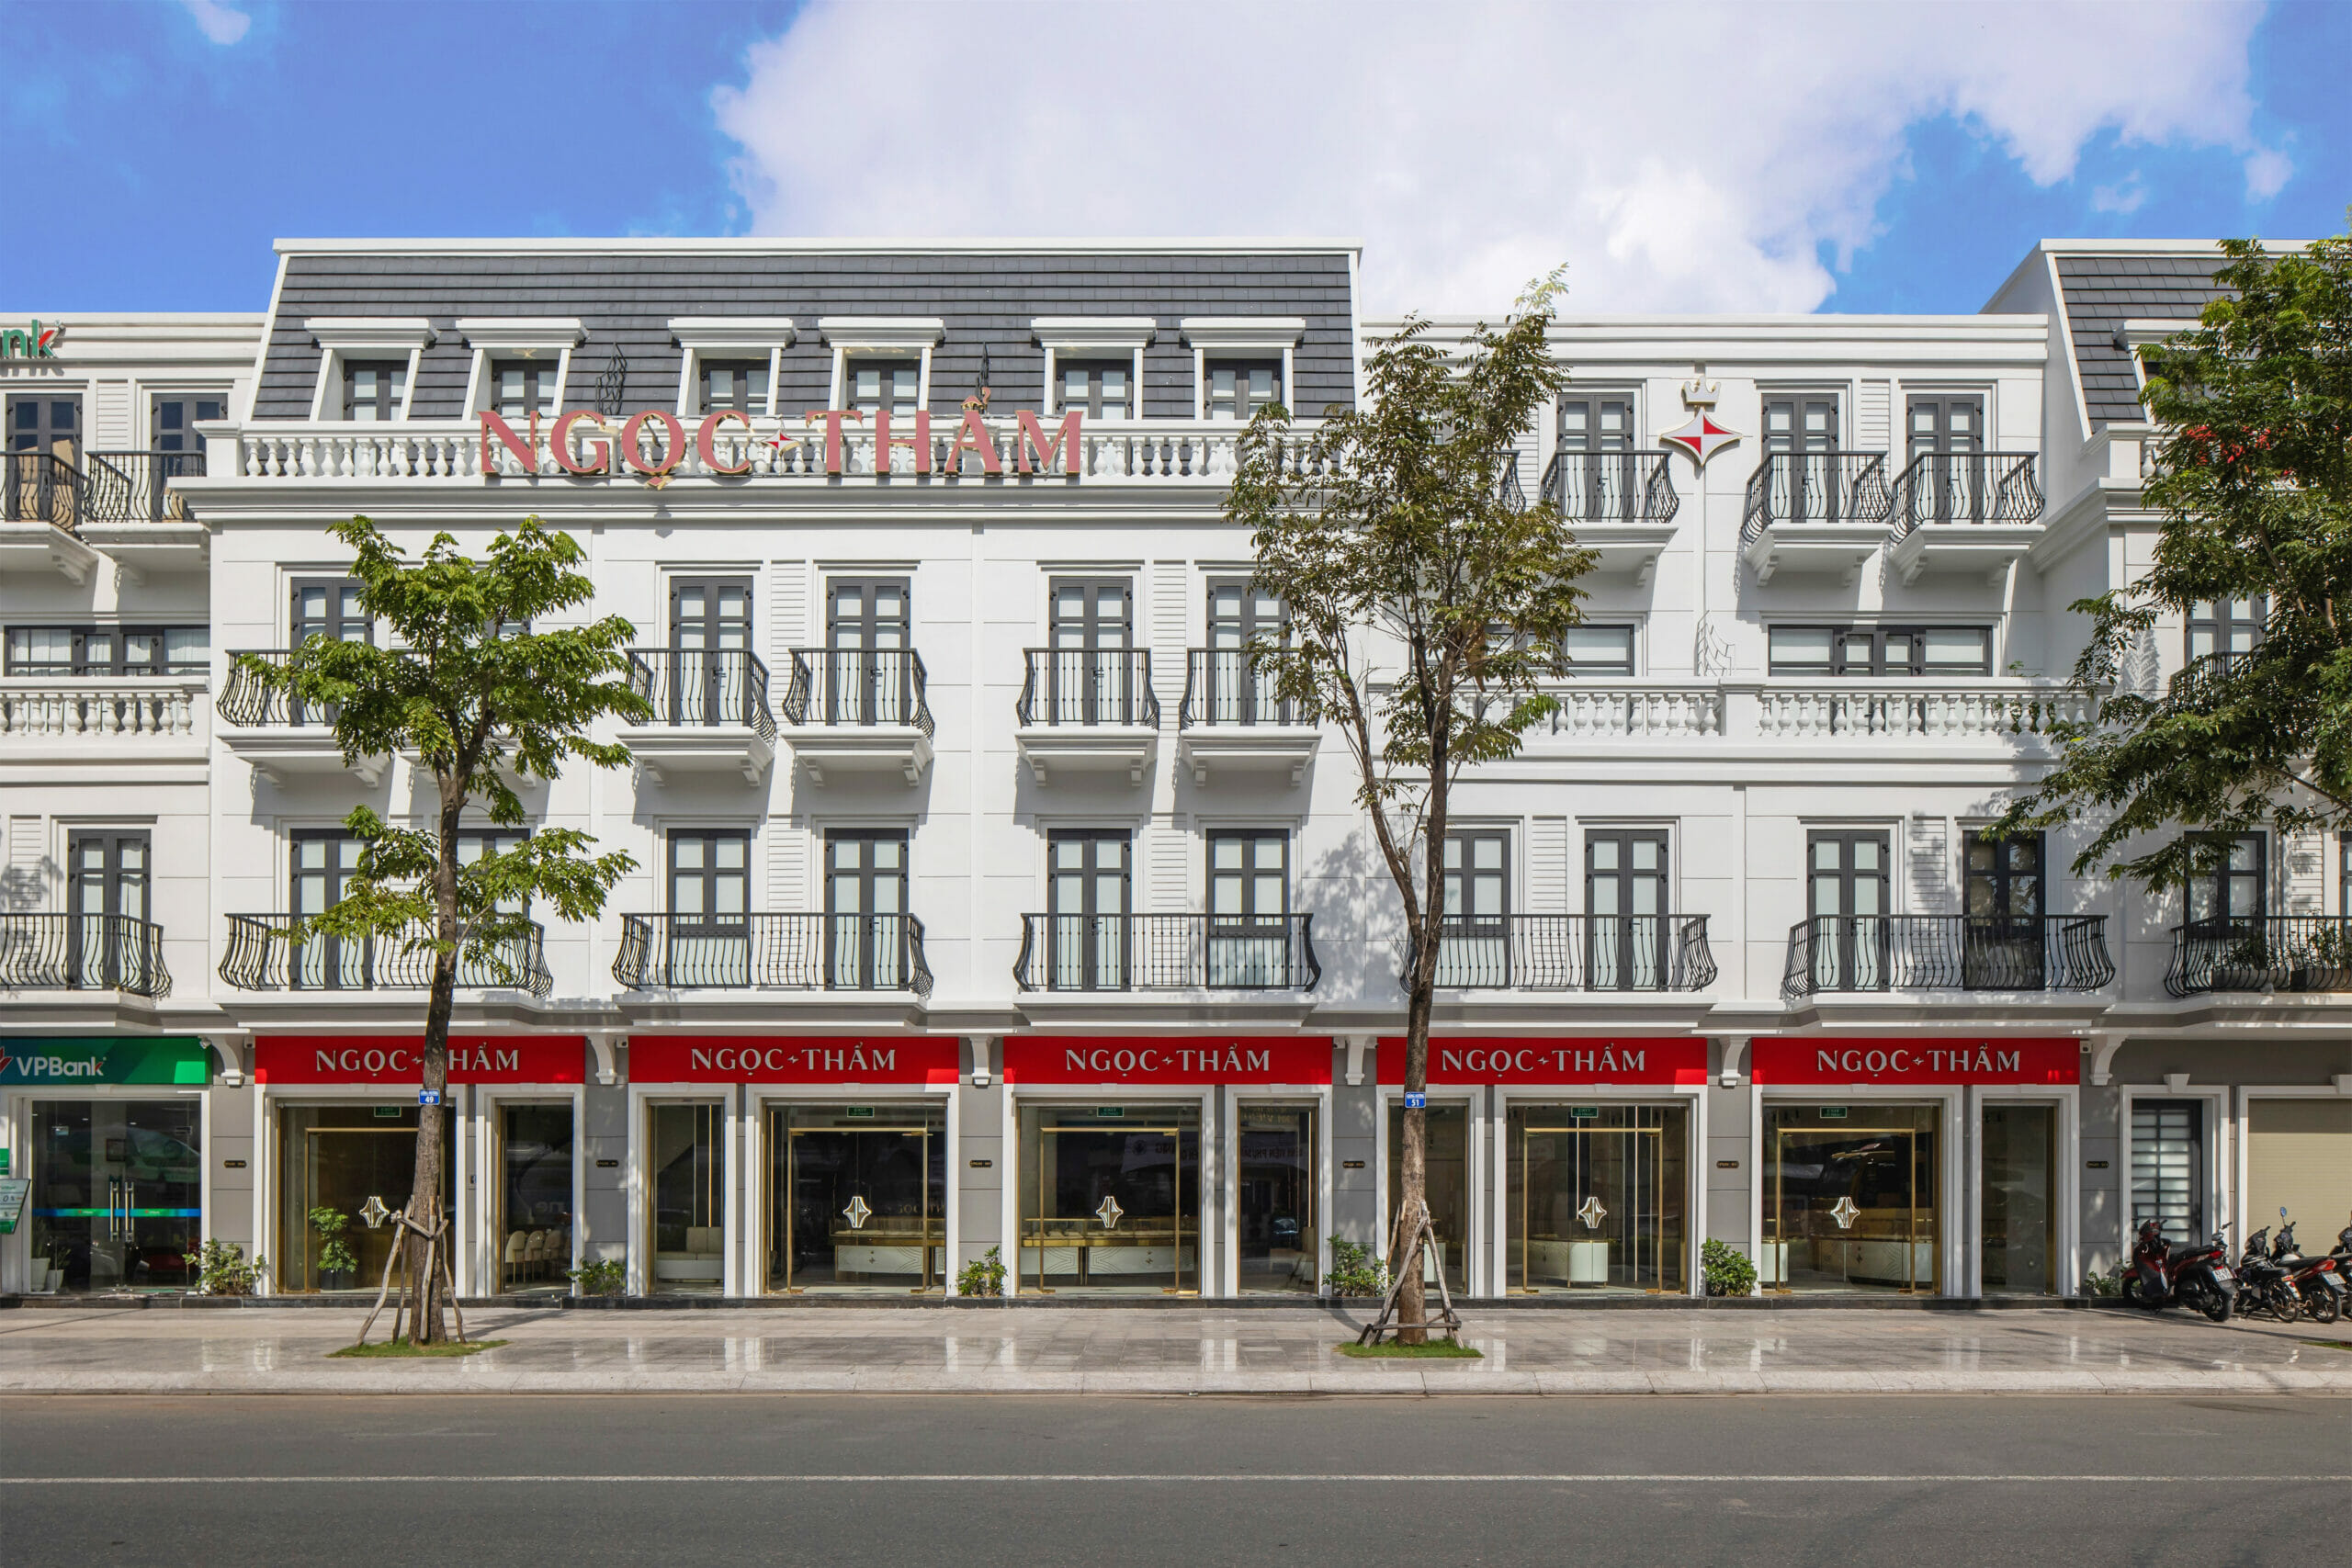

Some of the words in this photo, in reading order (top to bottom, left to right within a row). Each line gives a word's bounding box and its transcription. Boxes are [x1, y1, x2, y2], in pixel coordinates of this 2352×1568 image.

[477, 410, 753, 489] NGỌC
[805, 387, 1084, 474] THẨM
[16, 1056, 104, 1077] VPBank
[315, 1049, 408, 1077] NGỌC
[447, 1042, 519, 1071] HẨM
[691, 1048, 785, 1076] NGỌC
[801, 1042, 896, 1071] THẨM
[1065, 1049, 1159, 1077] NGỌC
[1176, 1043, 1271, 1072] THẨM
[1442, 1049, 1534, 1077] NGỌC
[1551, 1043, 1645, 1072] THẨM
[1816, 1049, 1909, 1077] NGỌC
[1927, 1043, 2020, 1072] THẨM
[1411, 1099, 1419, 1107] 51
